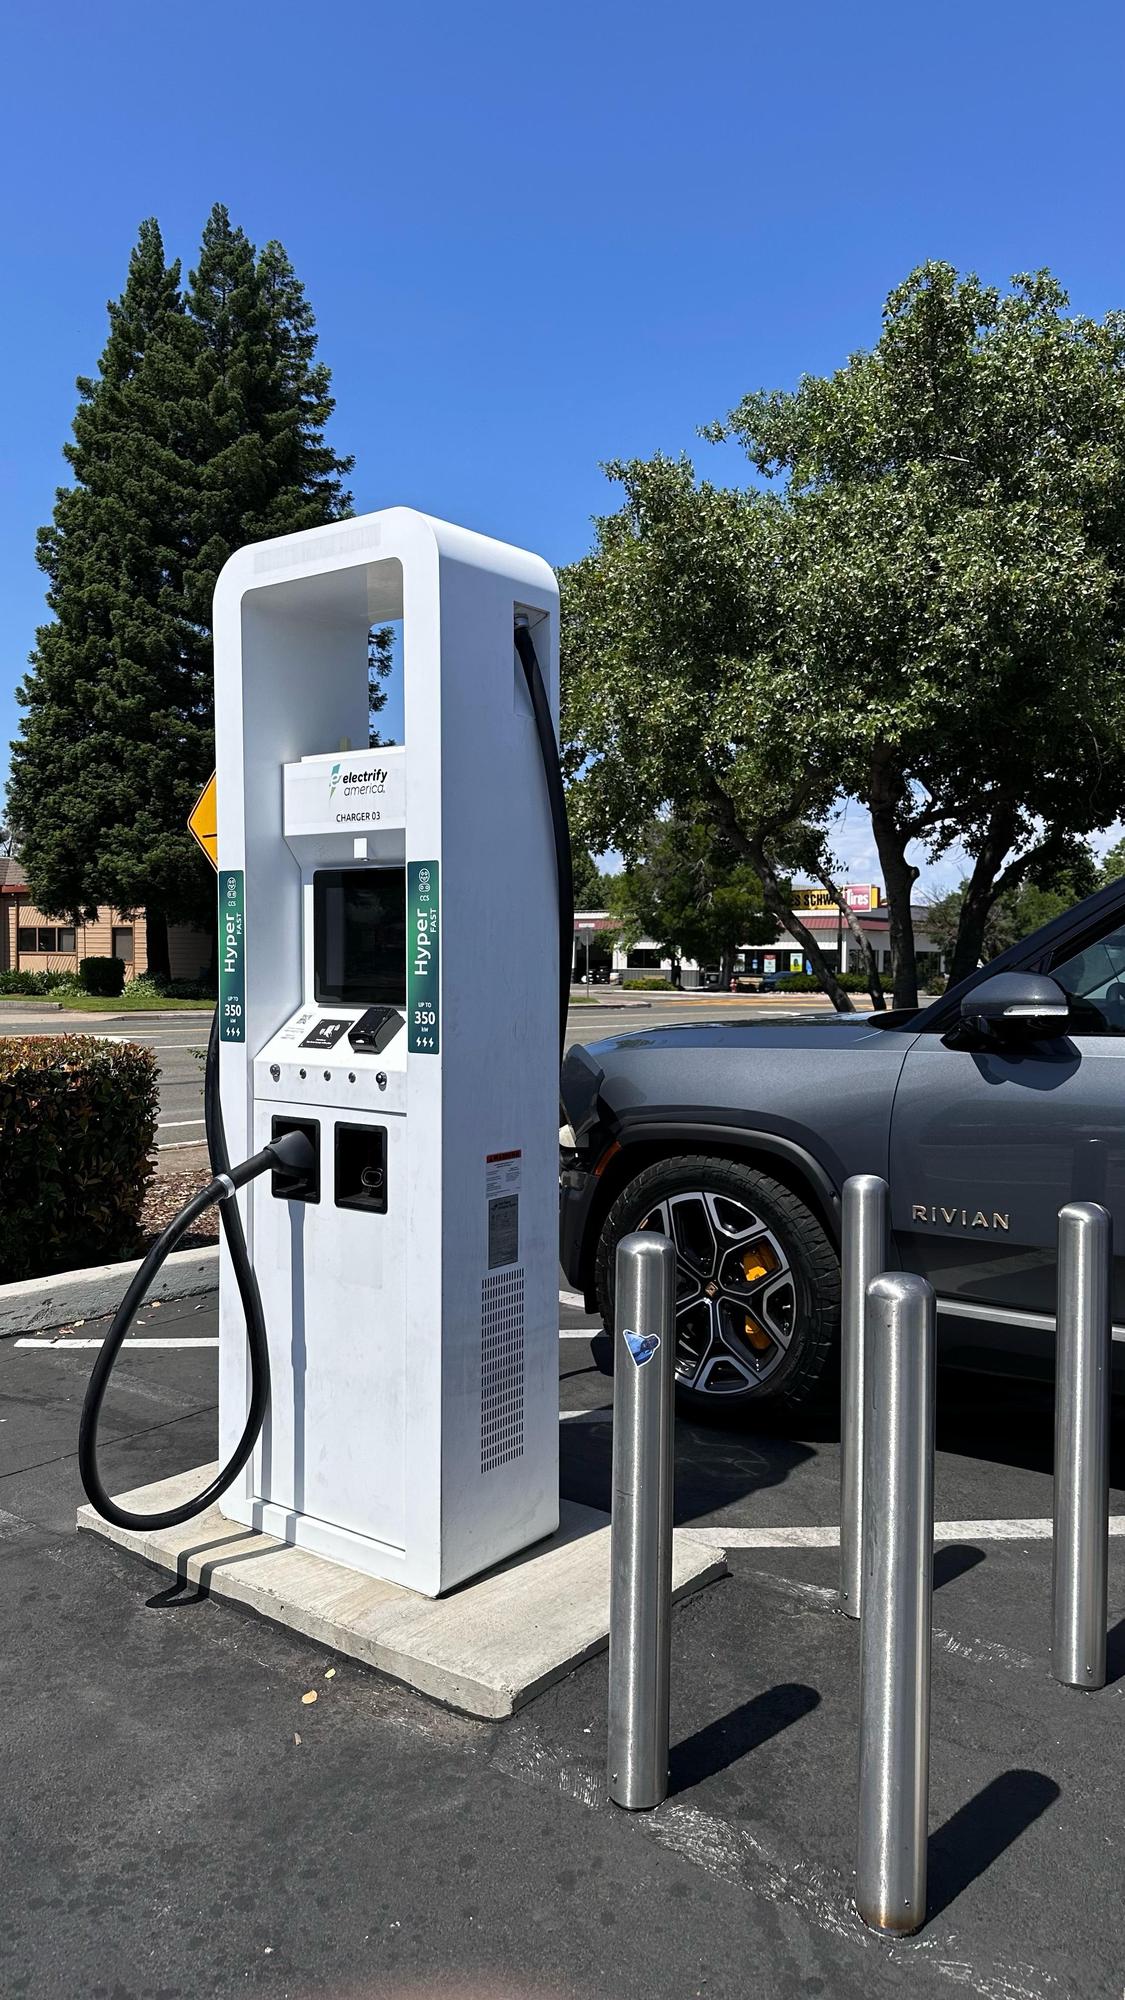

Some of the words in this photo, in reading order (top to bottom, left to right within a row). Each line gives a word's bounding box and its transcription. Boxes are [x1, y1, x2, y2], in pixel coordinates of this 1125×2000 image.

[342, 769, 388, 784] electrify
[344, 783, 384, 797] america
[336, 812, 370, 823] CHARGER
[371, 811, 381, 821] 03
[846, 888, 869, 906] Tires
[224, 912, 238, 973] Hyper
[414, 908, 431, 975] Hyper
[224, 1003, 242, 1017] 350
[414, 1010, 436, 1025] 350
[912, 1204, 1010, 1230] RIVIAN
